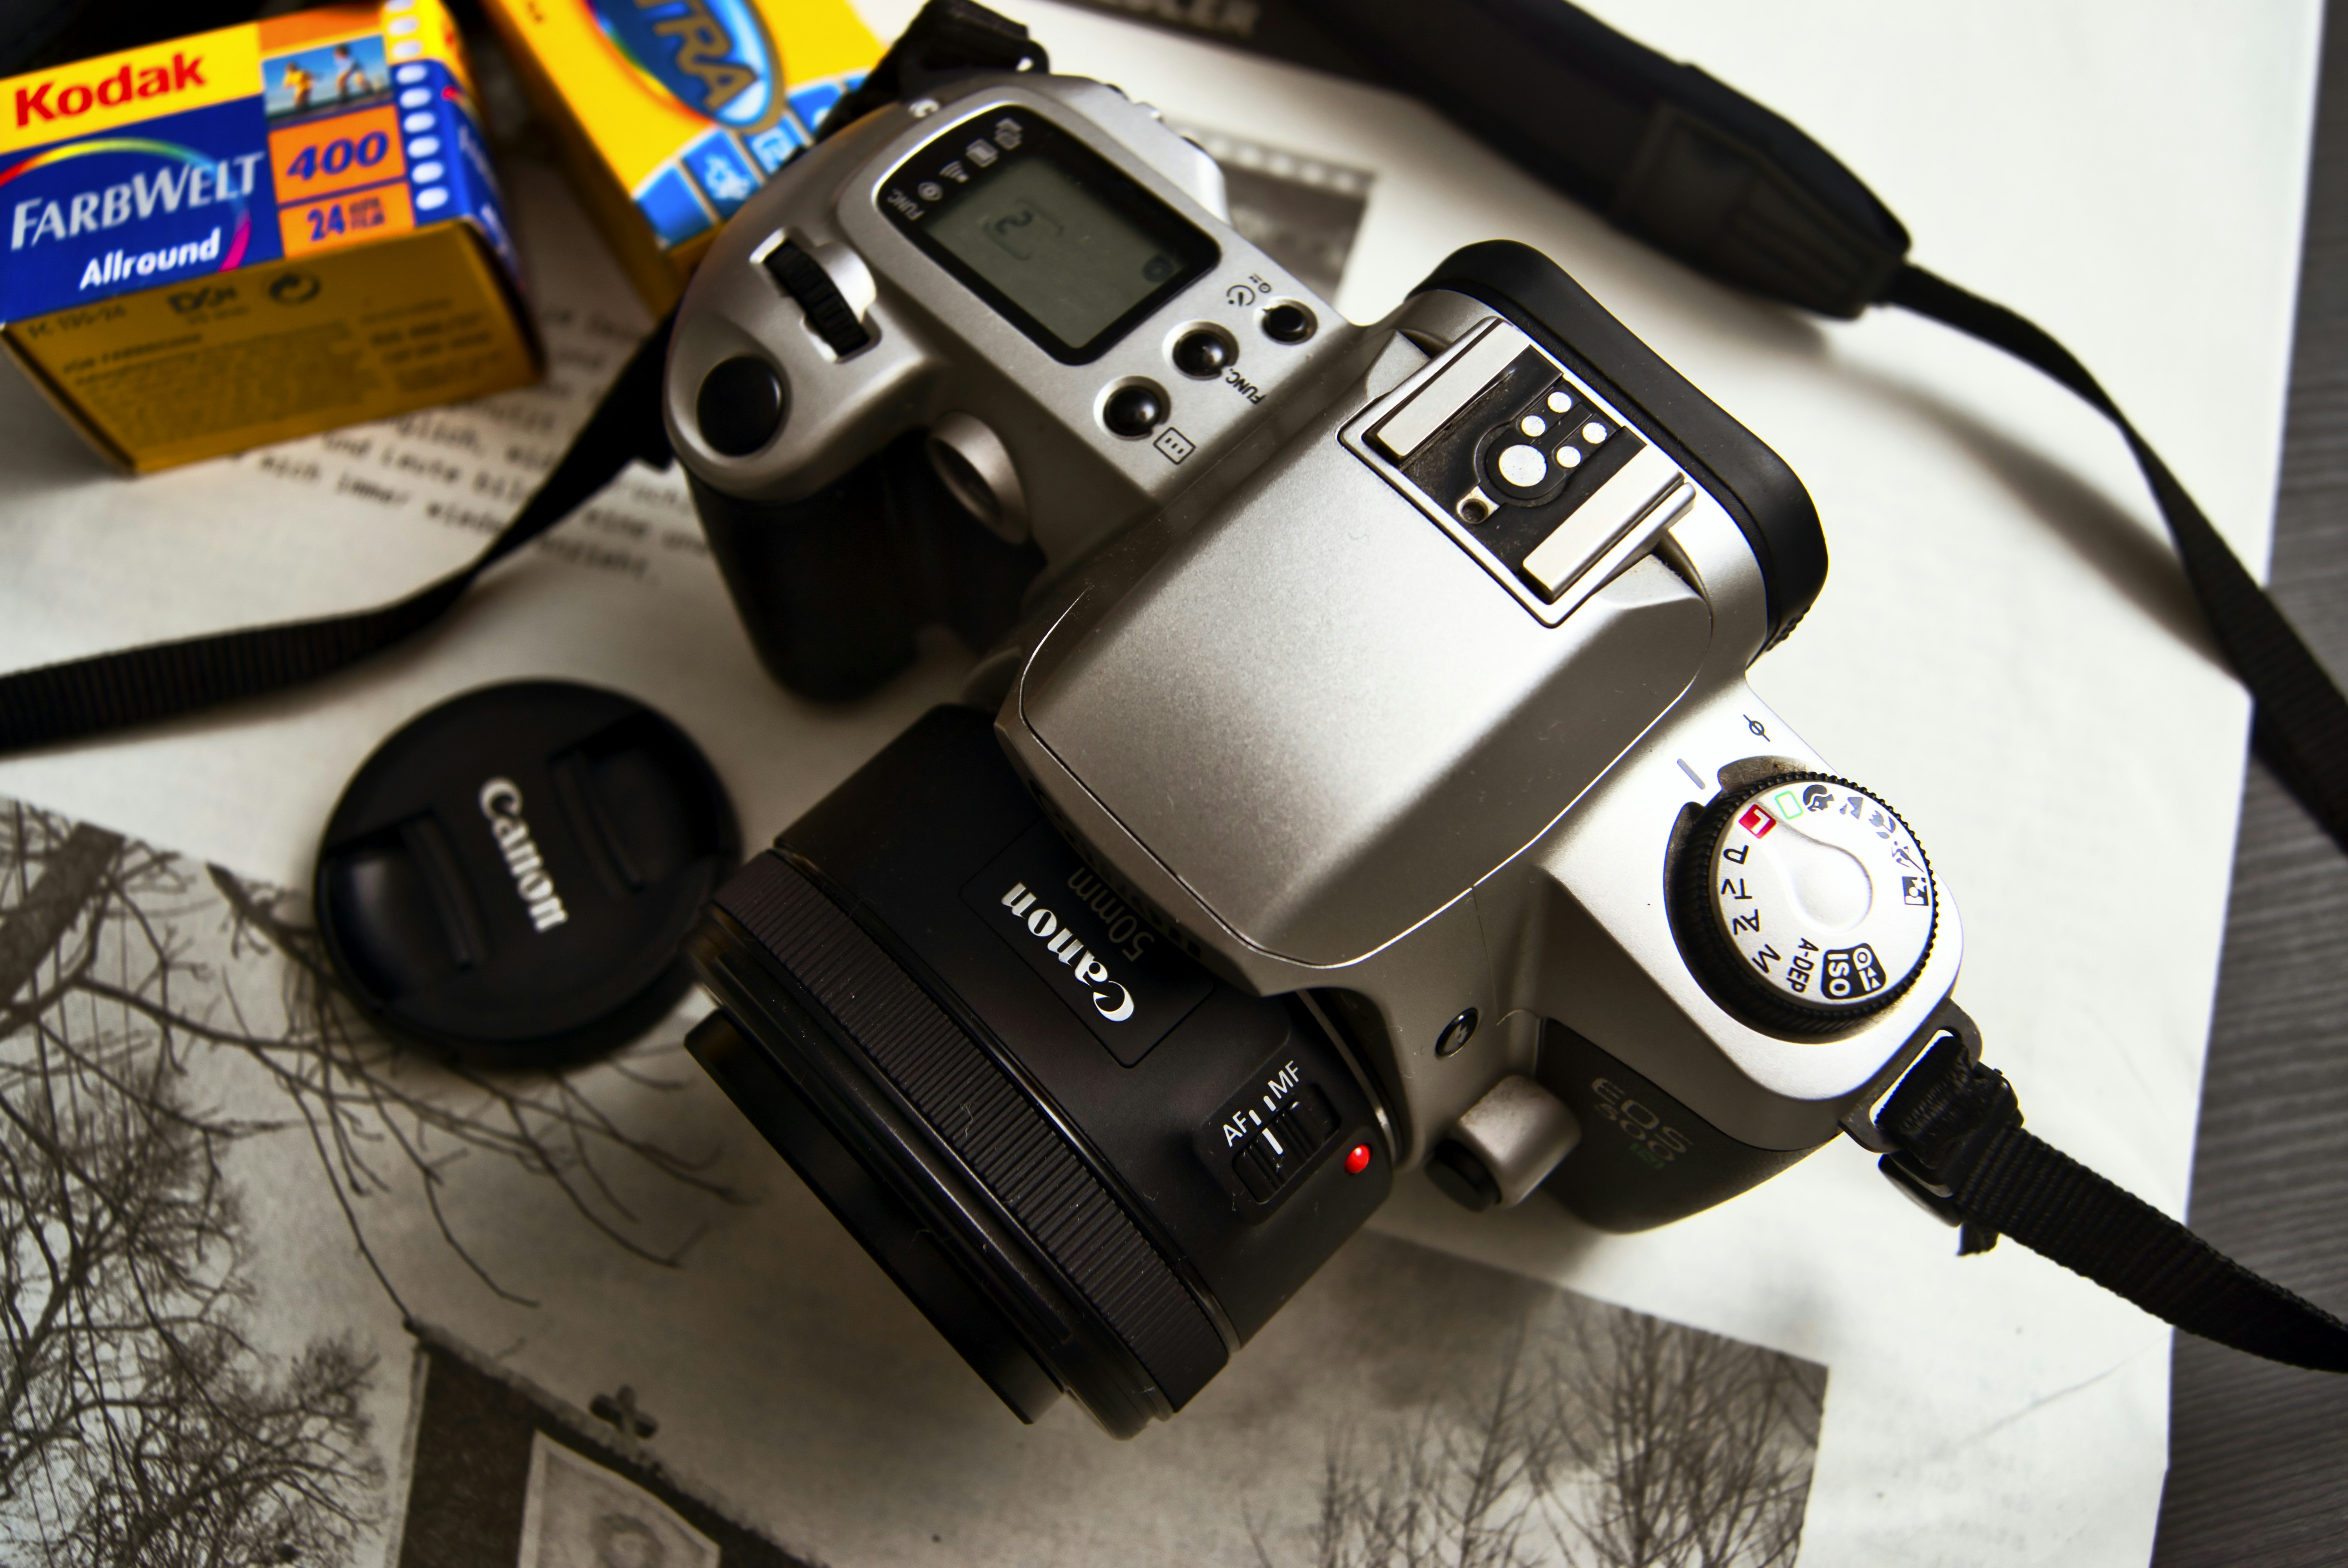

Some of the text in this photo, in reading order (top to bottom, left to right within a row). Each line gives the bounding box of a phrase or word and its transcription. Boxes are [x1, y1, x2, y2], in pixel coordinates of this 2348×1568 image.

[16, 52, 207, 129] Kodak
[286, 130, 389, 181] 400
[306, 203, 346, 243] 24
[79, 226, 221, 290] Allround
[1225, 368, 1267, 404] FUNC.
[479, 776, 569, 933] Canon
[1723, 844, 1749, 865] P
[1721, 878, 1752, 899] Tv
[1068, 867, 1155, 962] 50mm
[1733, 909, 1759, 935] Av
[1001, 881, 1134, 1022] Canon
[1751, 944, 1782, 973] M
[1786, 938, 1819, 993] A-DEP
[1828, 954, 1851, 997] ISO
[1268, 1060, 1299, 1099] MF
[1223, 1111, 1247, 1148] AF
[1591, 1077, 1693, 1153] EOS
[1593, 1102, 1675, 1161] 500
